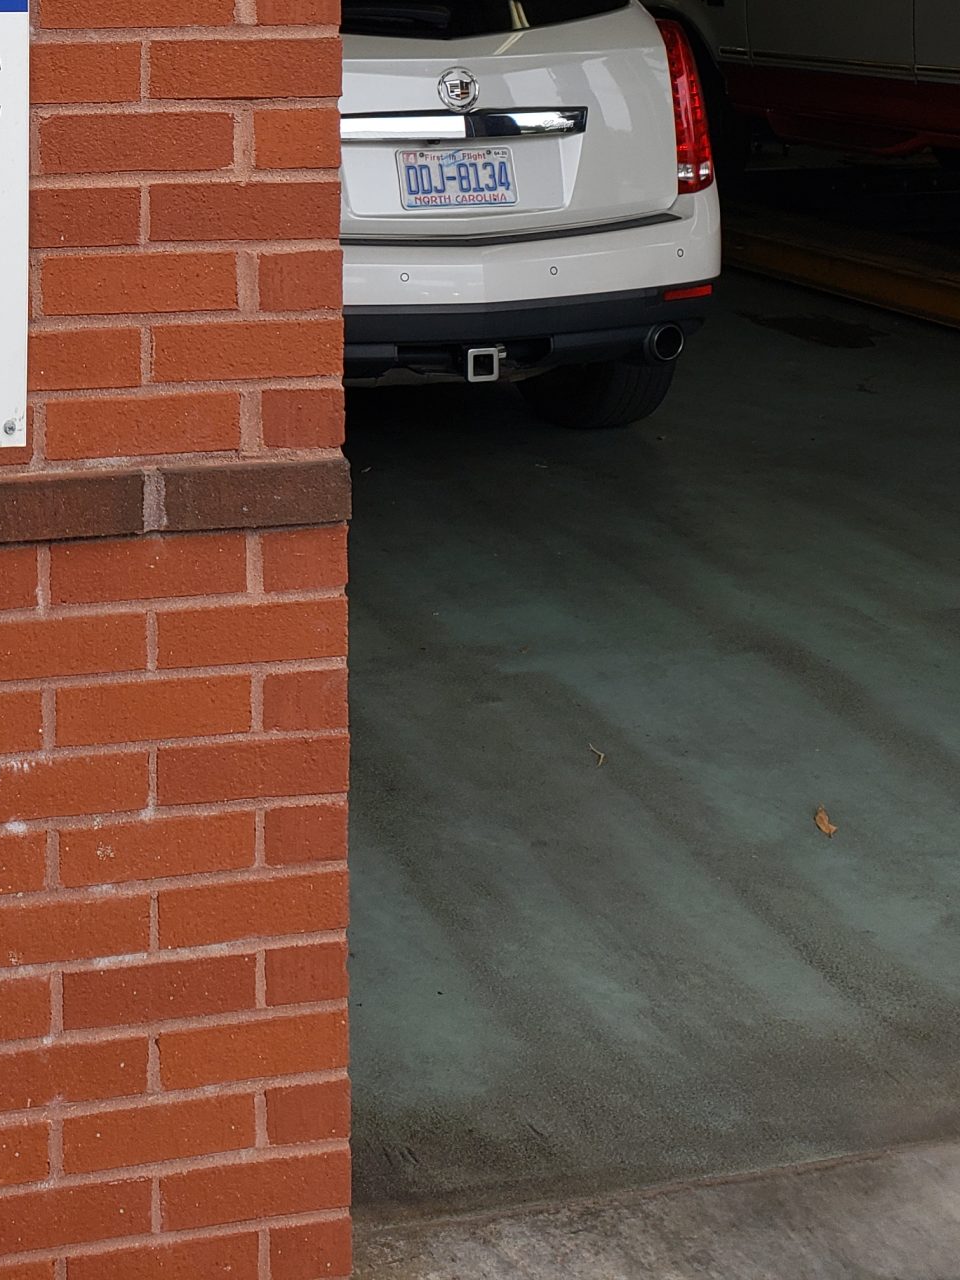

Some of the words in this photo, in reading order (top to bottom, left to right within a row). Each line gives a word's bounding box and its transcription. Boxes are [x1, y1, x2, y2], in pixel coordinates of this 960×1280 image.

[424, 153, 444, 162] First
[461, 152, 487, 161] Flight
[405, 161, 510, 195] DDJ-8134
[414, 195, 451, 205] NORTH
[455, 193, 508, 203] CAROLINA
